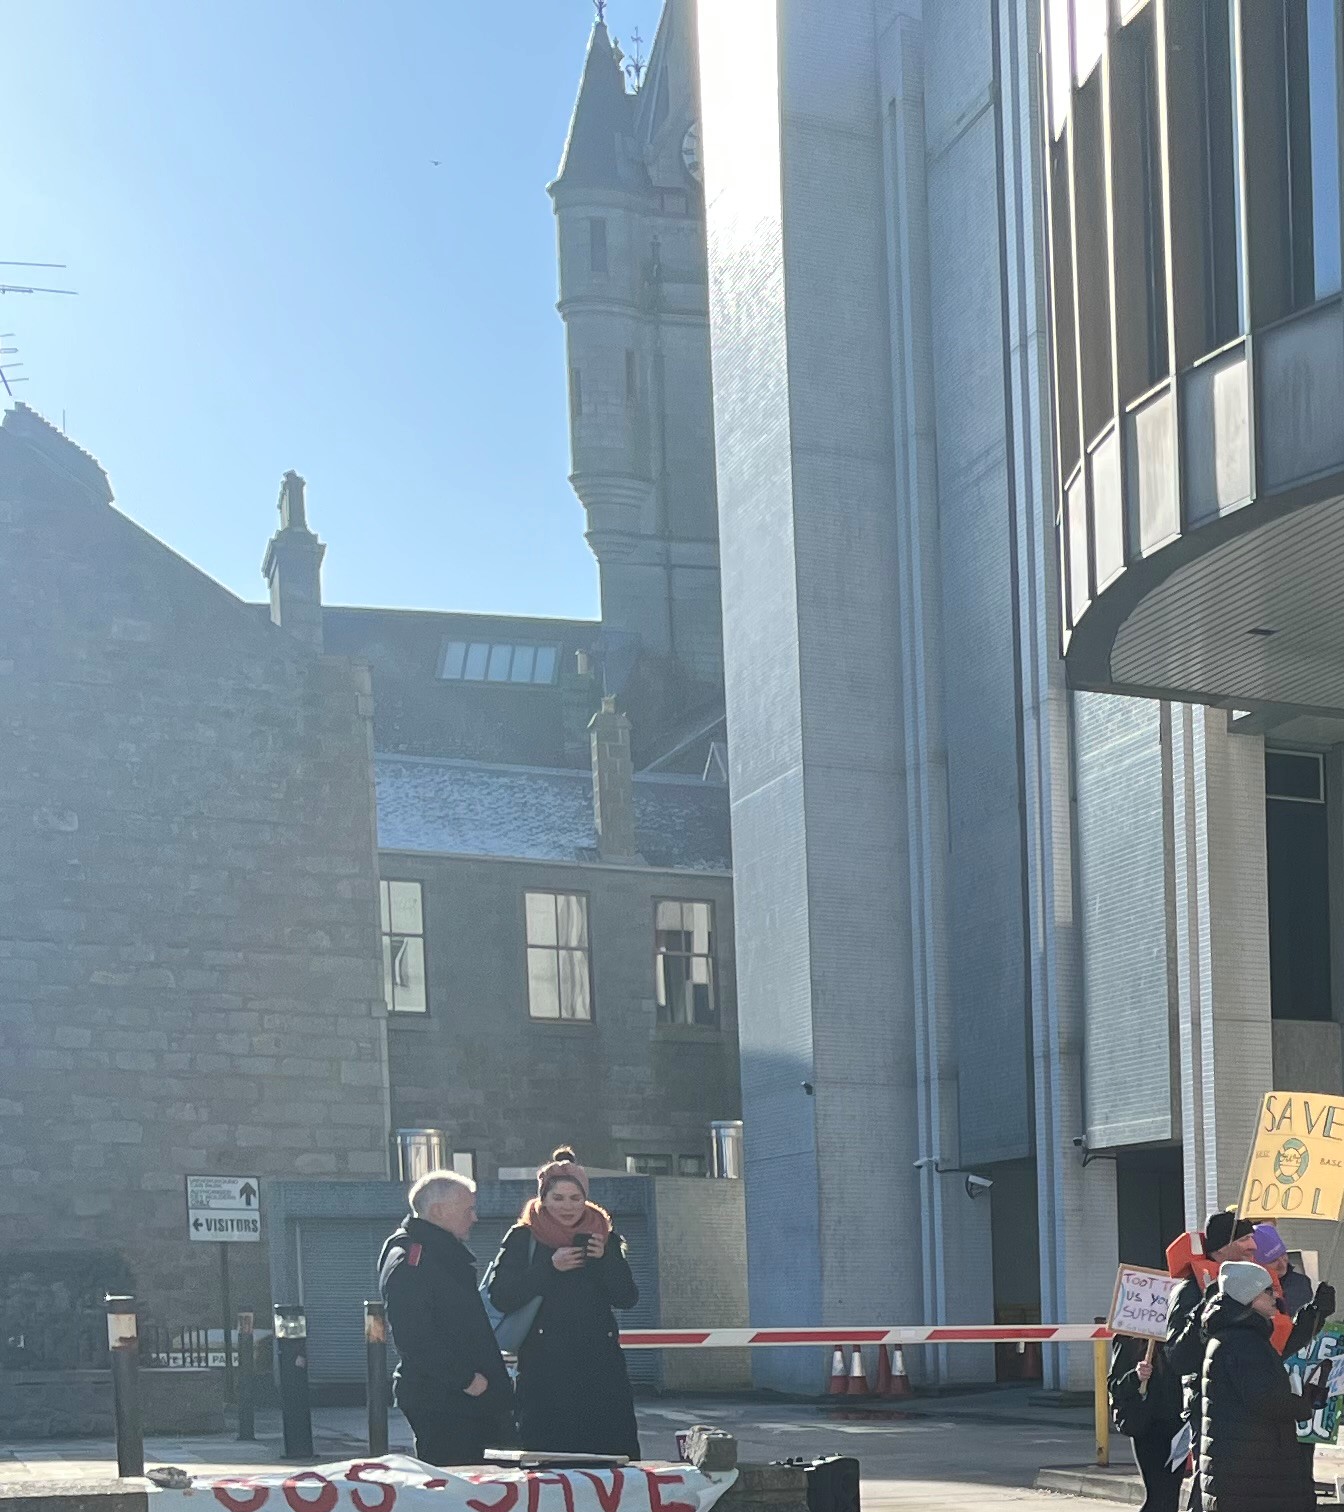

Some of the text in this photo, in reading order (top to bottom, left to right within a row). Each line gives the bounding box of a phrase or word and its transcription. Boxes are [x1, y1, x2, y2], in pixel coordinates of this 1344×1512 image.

[1246, 1178, 1326, 1217] POOL
[205, 1217, 259, 1234] VISITORS
[1123, 1272, 1160, 1290] TOOT
[1126, 1290, 1143, 1303] US
